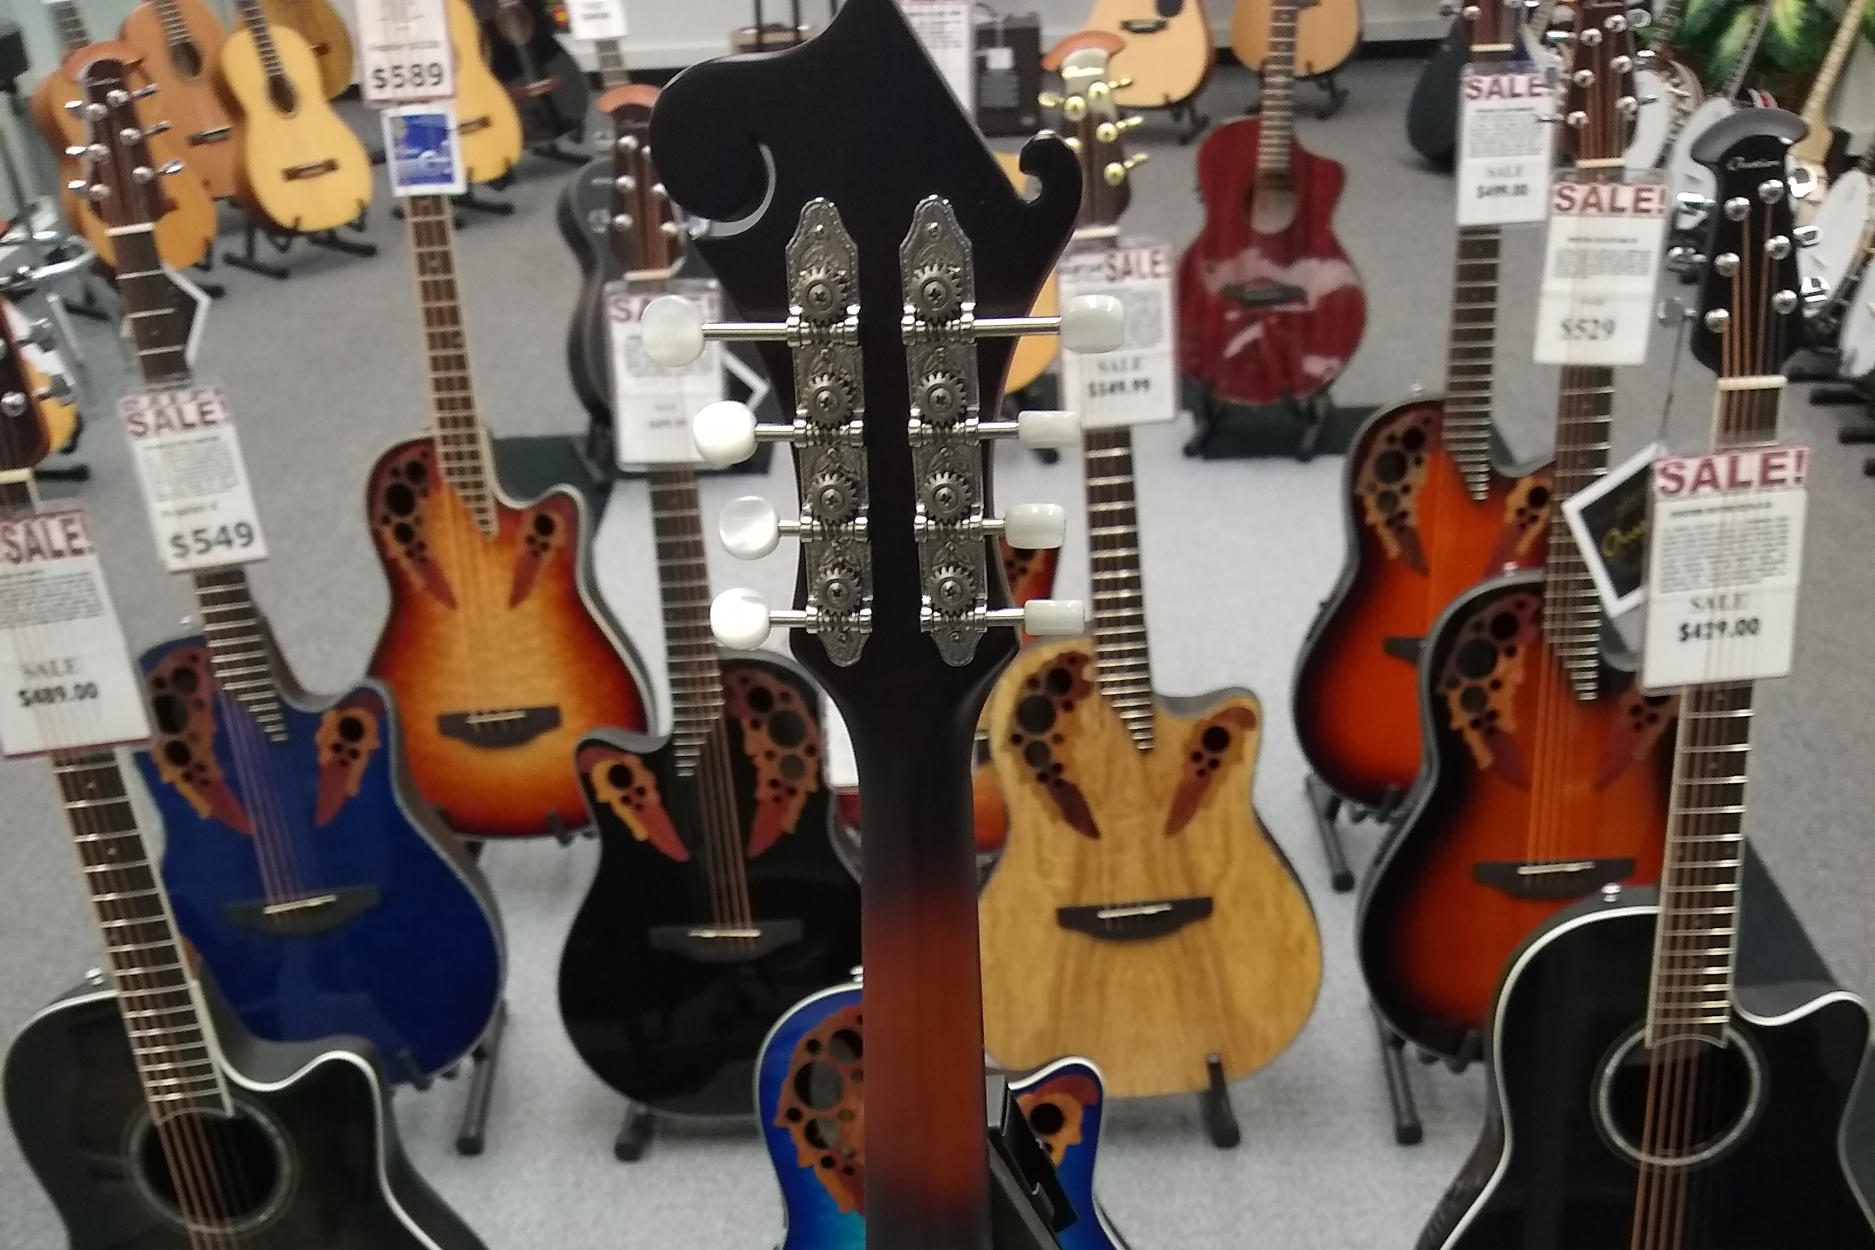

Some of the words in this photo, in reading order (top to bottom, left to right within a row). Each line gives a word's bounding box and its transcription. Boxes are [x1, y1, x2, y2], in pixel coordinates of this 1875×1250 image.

[373, 62, 444, 89] $589
[1555, 184, 1667, 213] SALE!
[1560, 318, 1617, 341] $529
[1659, 450, 1808, 495] SALE!
[168, 520, 255, 559] $549
[1688, 592, 1749, 614] SALE
[22, 656, 78, 680] SALE
